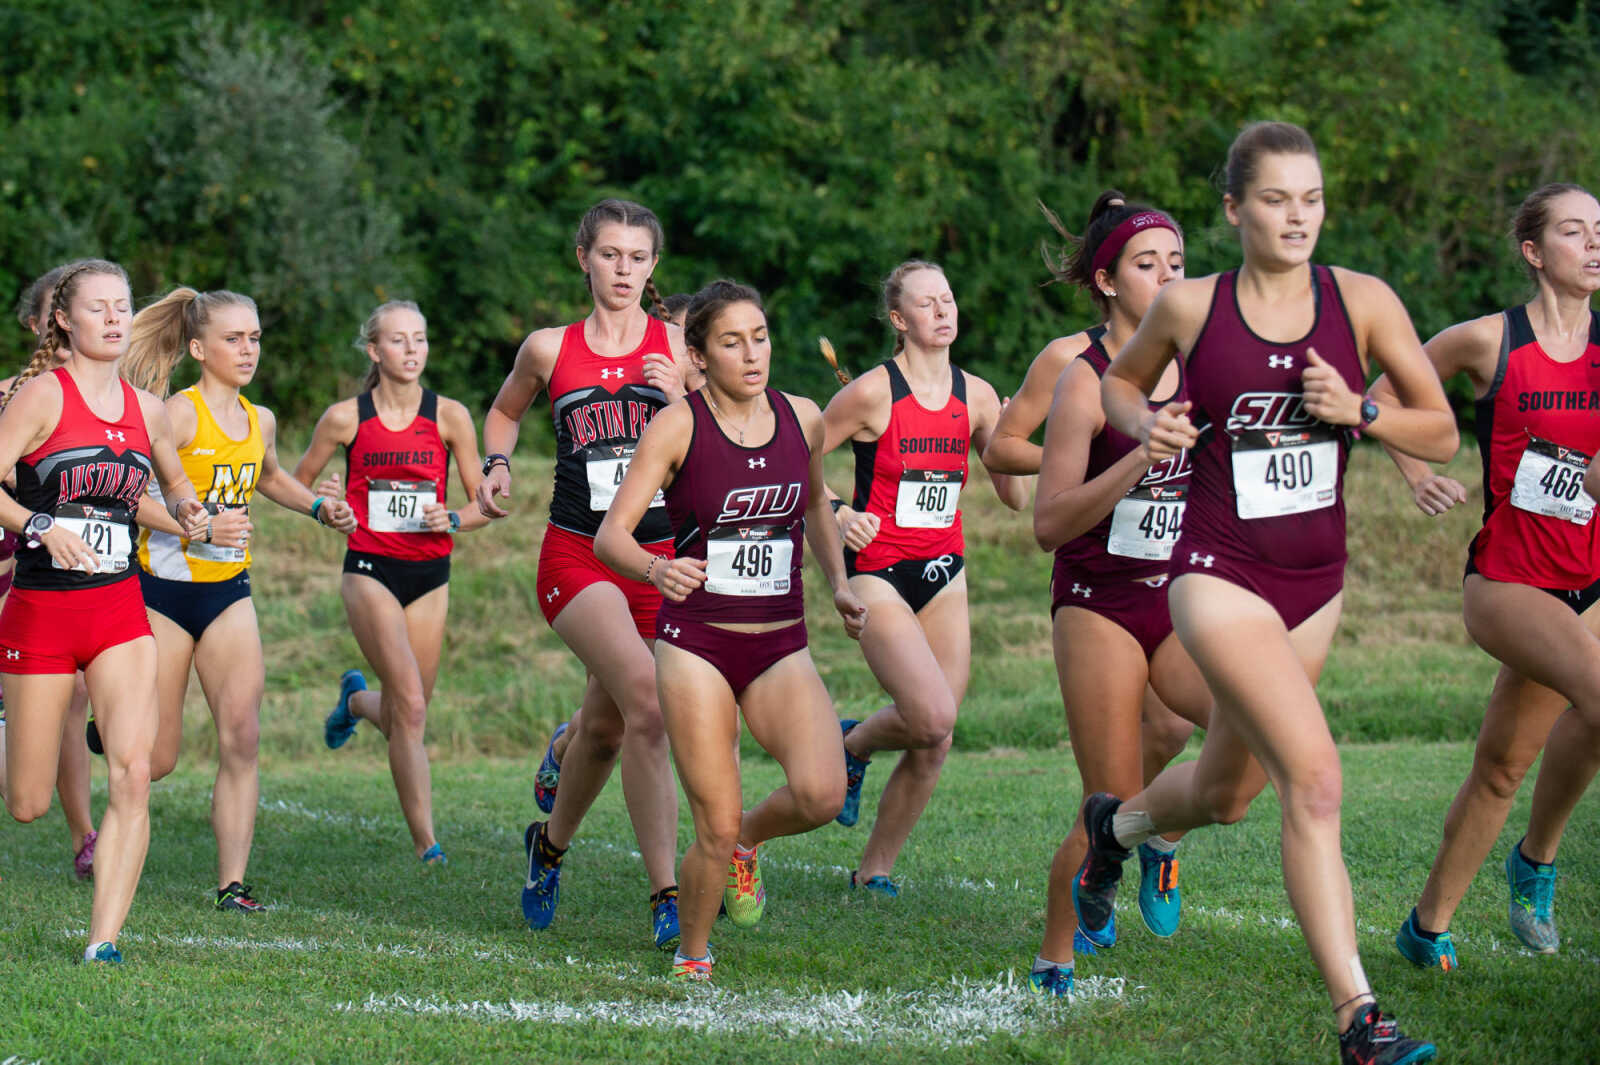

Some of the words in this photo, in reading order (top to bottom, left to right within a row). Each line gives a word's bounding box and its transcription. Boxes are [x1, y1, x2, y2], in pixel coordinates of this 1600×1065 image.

[628, 400, 658, 439] PE
[363, 451, 434, 467] SOUTHEAST
[900, 437, 965, 455] SOUTHEAST
[57, 462, 125, 504] AUSTIN
[613, 462, 629, 485] 4
[1139, 447, 1193, 485] SI
[1265, 450, 1313, 491] 490
[1540, 464, 1584, 501] 466
[204, 463, 256, 505] M
[916, 486, 947, 512] 460
[387, 495, 417, 518] 467
[717, 483, 801, 523] SIU
[81, 523, 112, 555] 421
[1138, 506, 1182, 540] 494
[732, 544, 773, 577] 496
